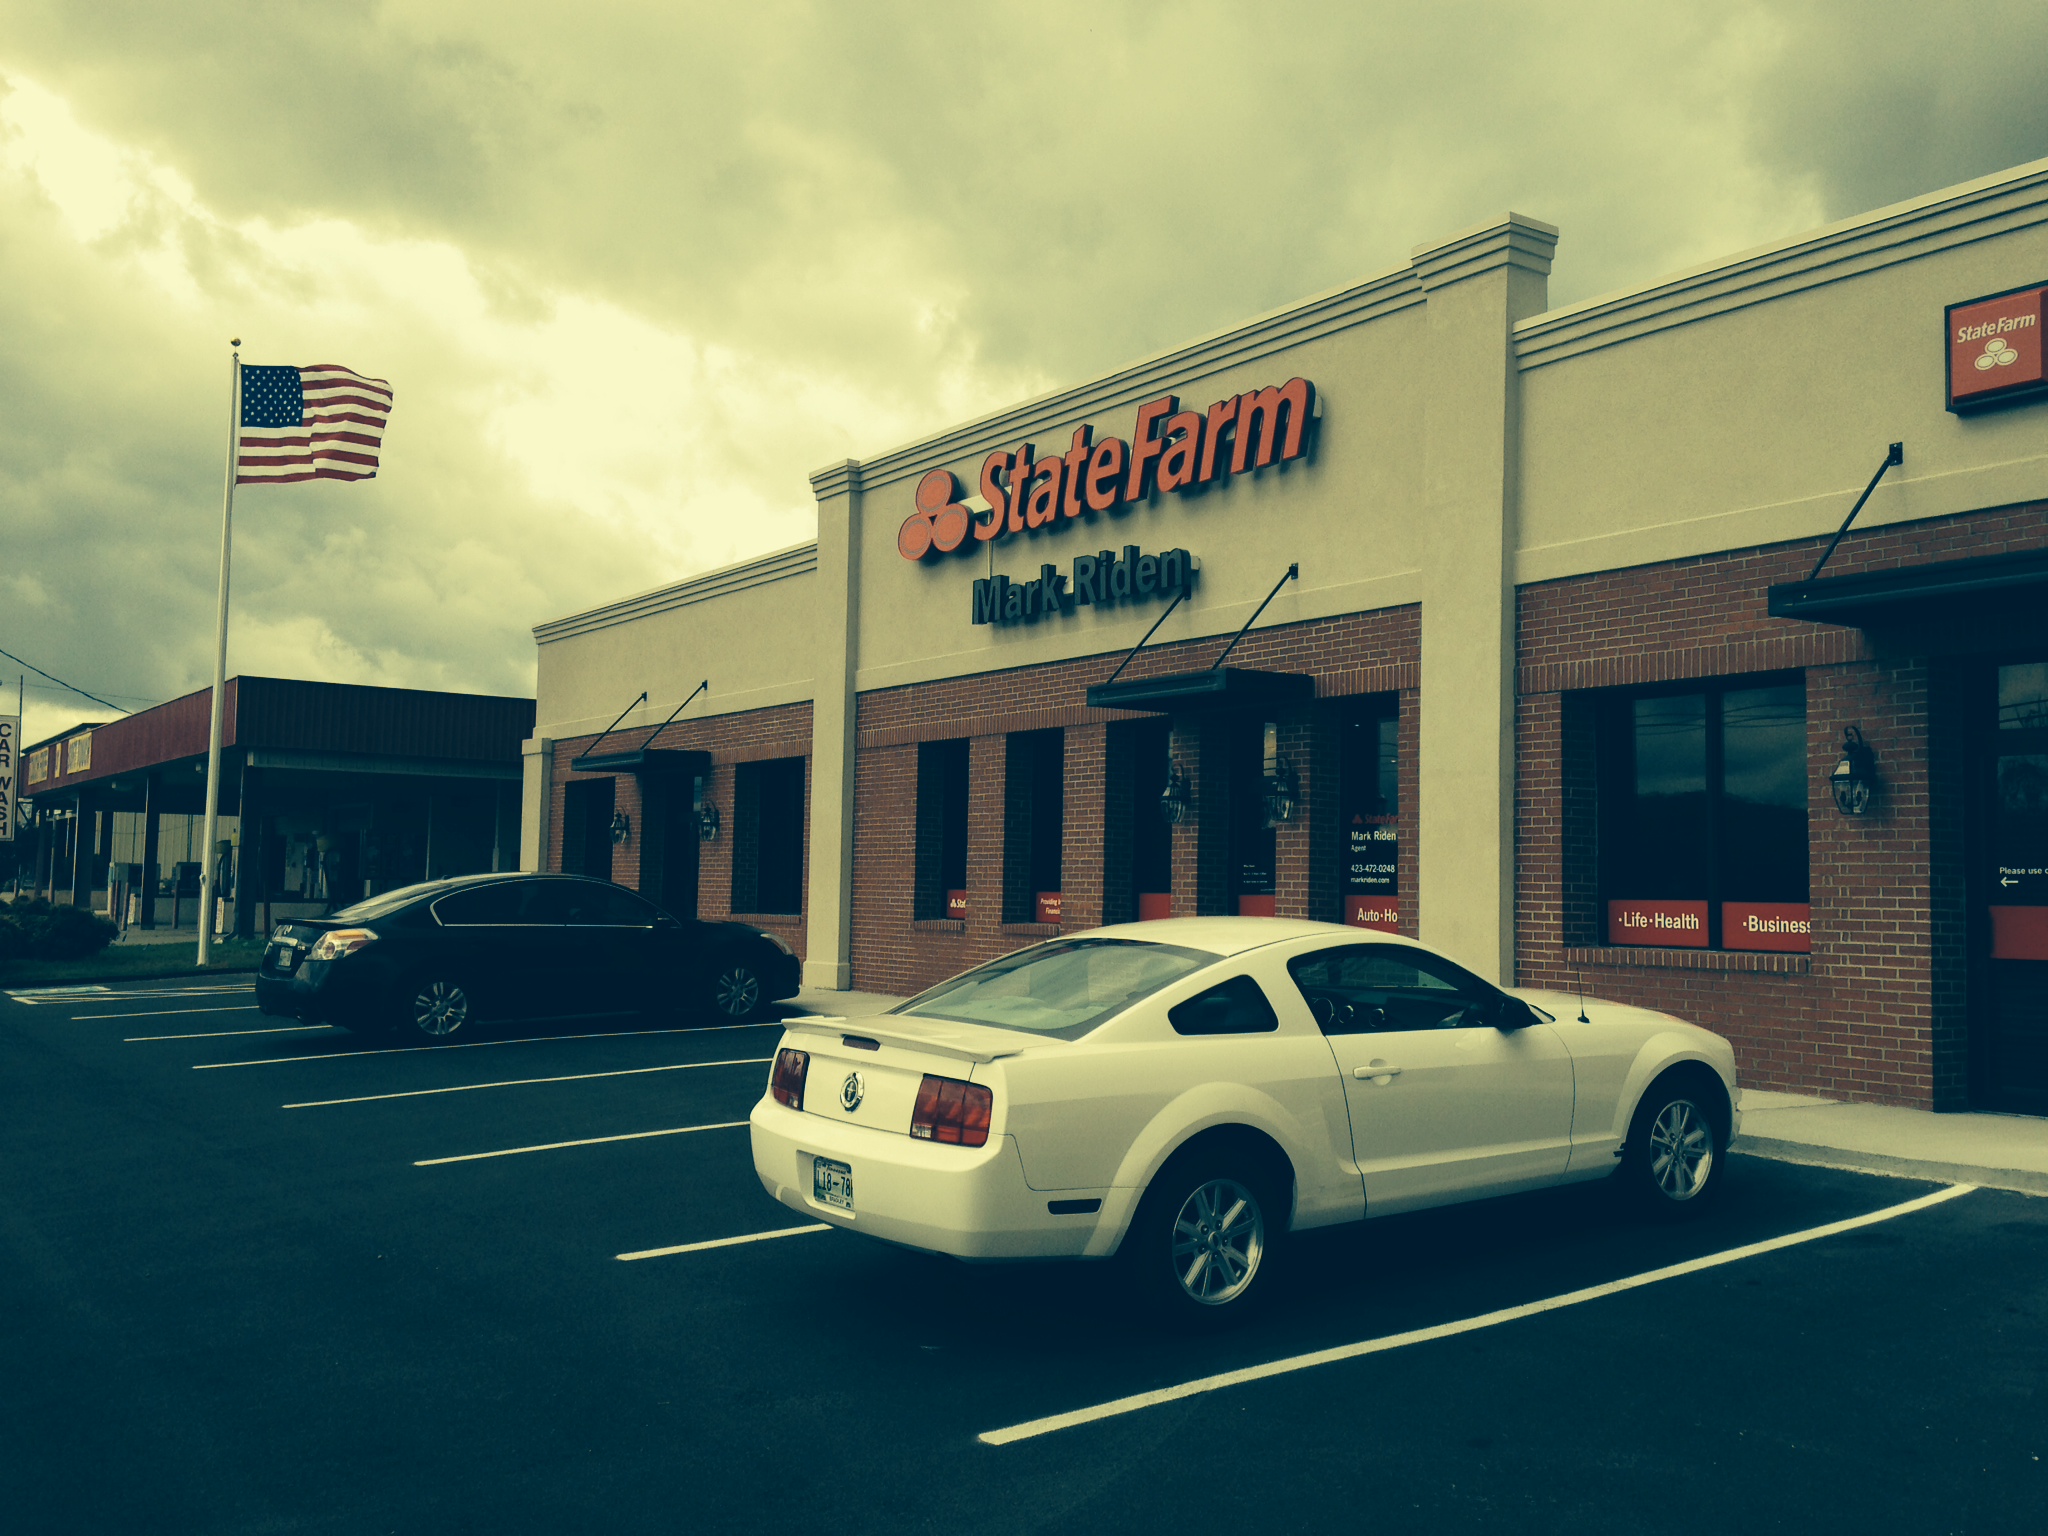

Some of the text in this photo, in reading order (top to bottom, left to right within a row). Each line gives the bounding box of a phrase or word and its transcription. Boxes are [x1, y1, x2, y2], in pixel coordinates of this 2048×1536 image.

[972, 545, 1193, 625] Mark Riden
[0, 723, 12, 768] CAR
[0, 776, 12, 836] WASH
[1351, 830, 1397, 841] Mark Riden
[1351, 845, 1367, 853] Agent
[1351, 864, 1395, 873] 423-472-0248
[1999, 867, 2026, 875] Please
